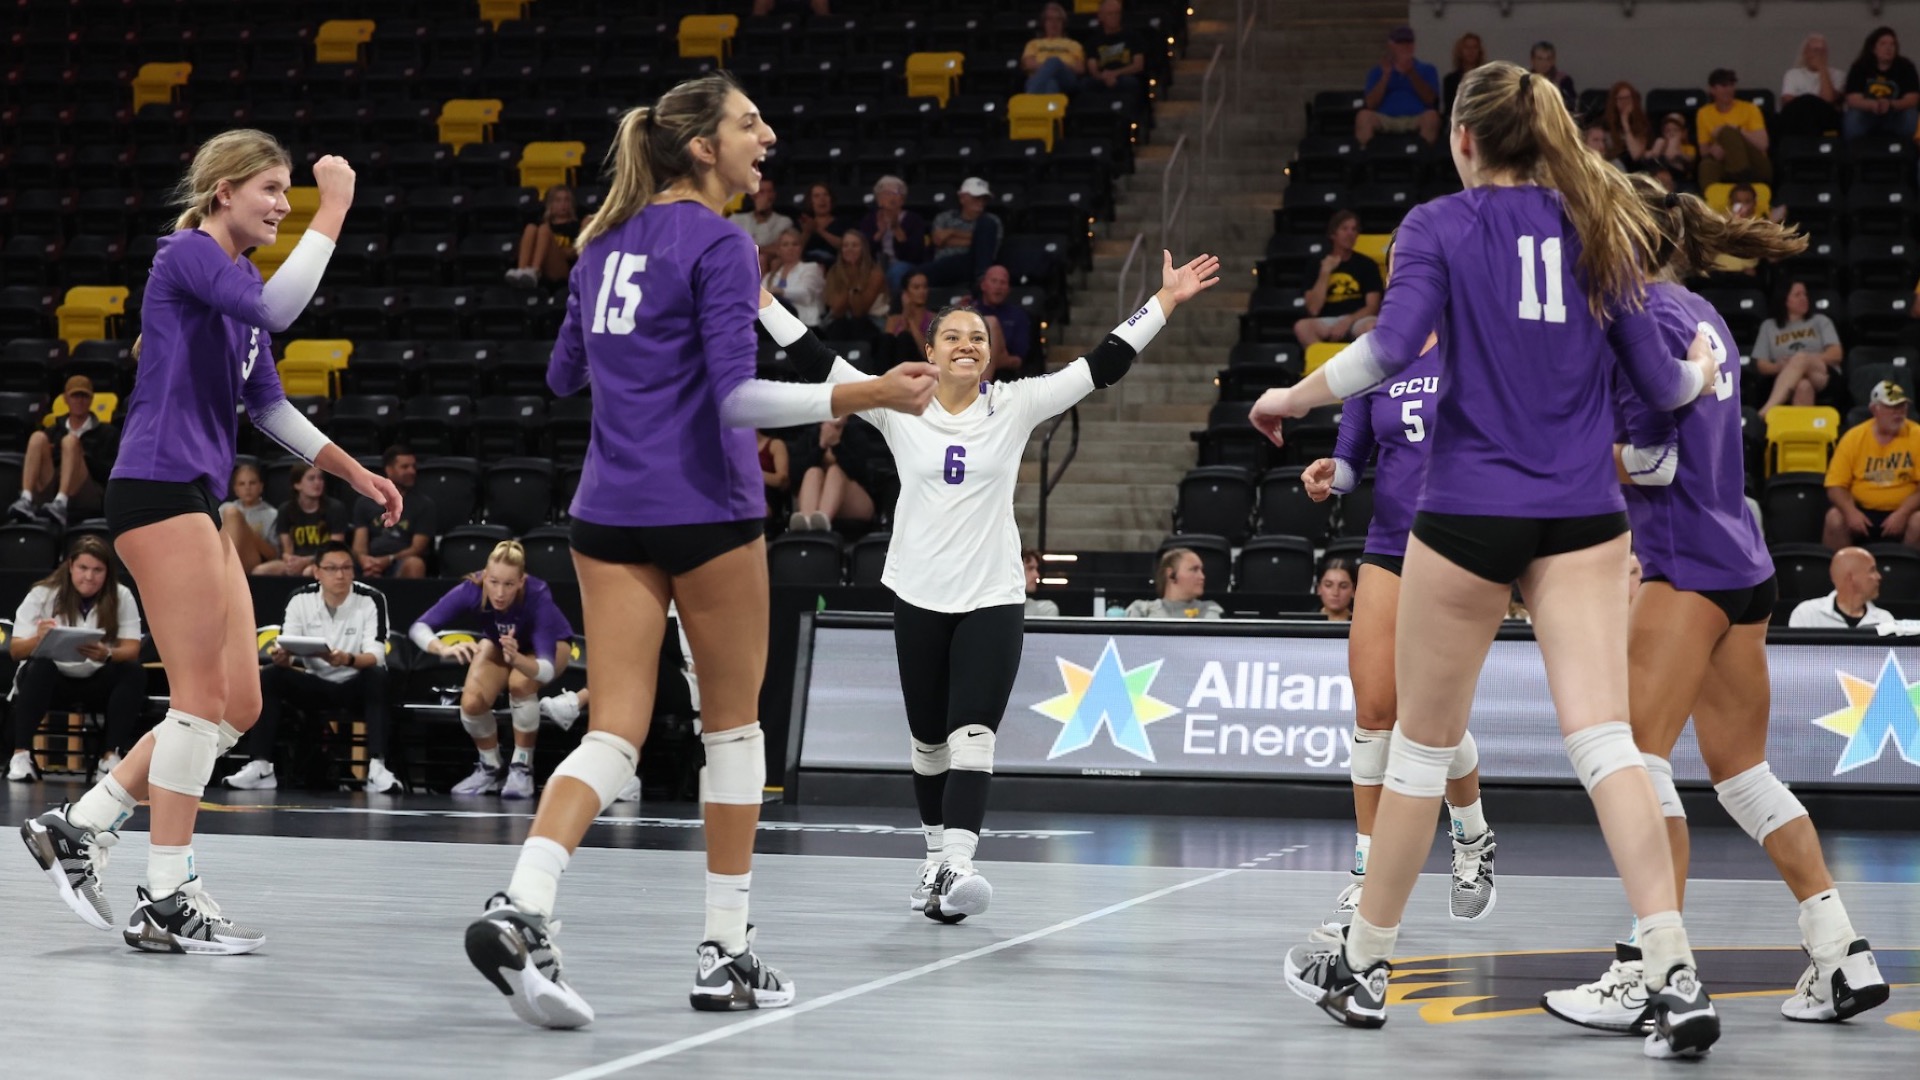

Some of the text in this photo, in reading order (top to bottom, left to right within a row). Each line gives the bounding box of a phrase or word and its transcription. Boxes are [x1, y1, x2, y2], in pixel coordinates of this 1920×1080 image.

[591, 250, 648, 335] 15
[1517, 235, 1566, 323] 11
[1127, 307, 1149, 327] GCU
[1775, 327, 1817, 347] IOWA
[1697, 321, 1734, 402] 2
[1389, 376, 1440, 399] GCU
[1401, 399, 1426, 443] 5
[943, 444, 967, 485] 6
[1864, 451, 1915, 473] IOWA
[1187, 660, 1354, 711] Allian
[1081, 768, 1141, 776] DAKTRONICS
